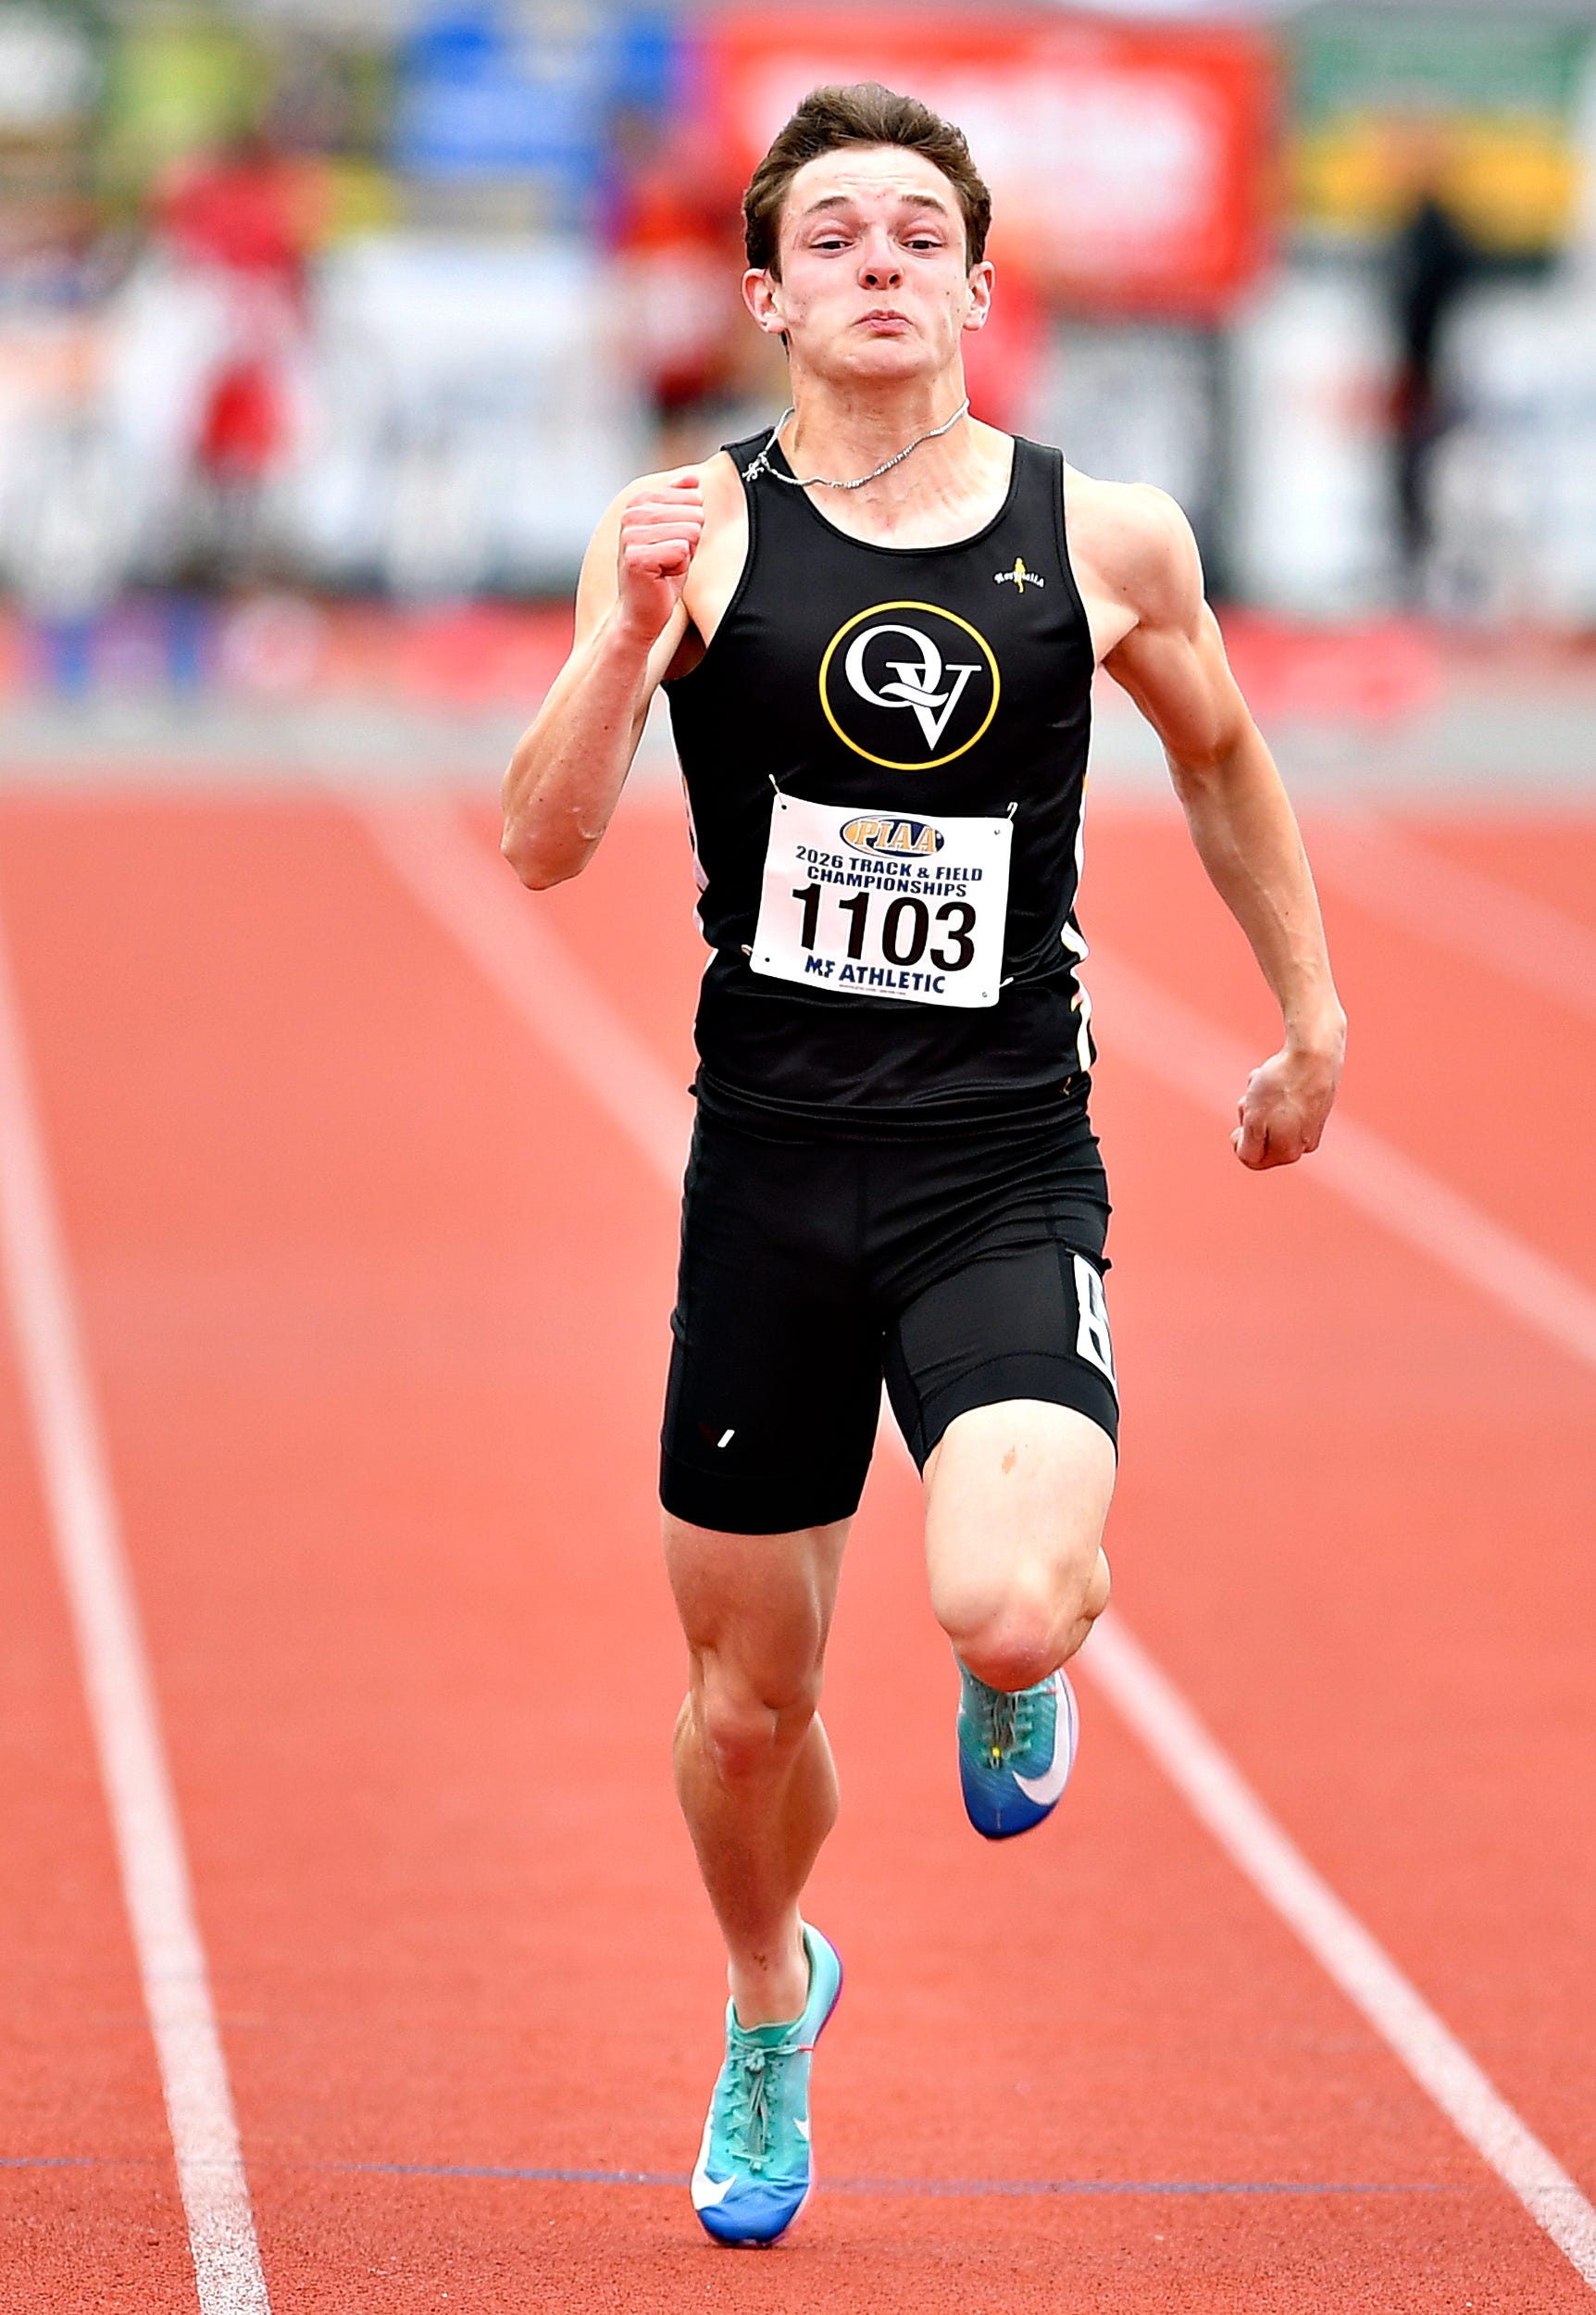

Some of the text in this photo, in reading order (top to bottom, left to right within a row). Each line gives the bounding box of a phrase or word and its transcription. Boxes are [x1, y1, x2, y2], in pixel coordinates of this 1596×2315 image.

[845, 624, 982, 751] QV
[854, 820, 936, 853] PIAA
[795, 845, 983, 881] 2026 TRACK & FIELD
[807, 866, 966, 897] CHAMPIONSHIPS
[792, 882, 977, 971] 1103
[804, 955, 835, 978] MF
[839, 964, 946, 994] ATHLETIC
